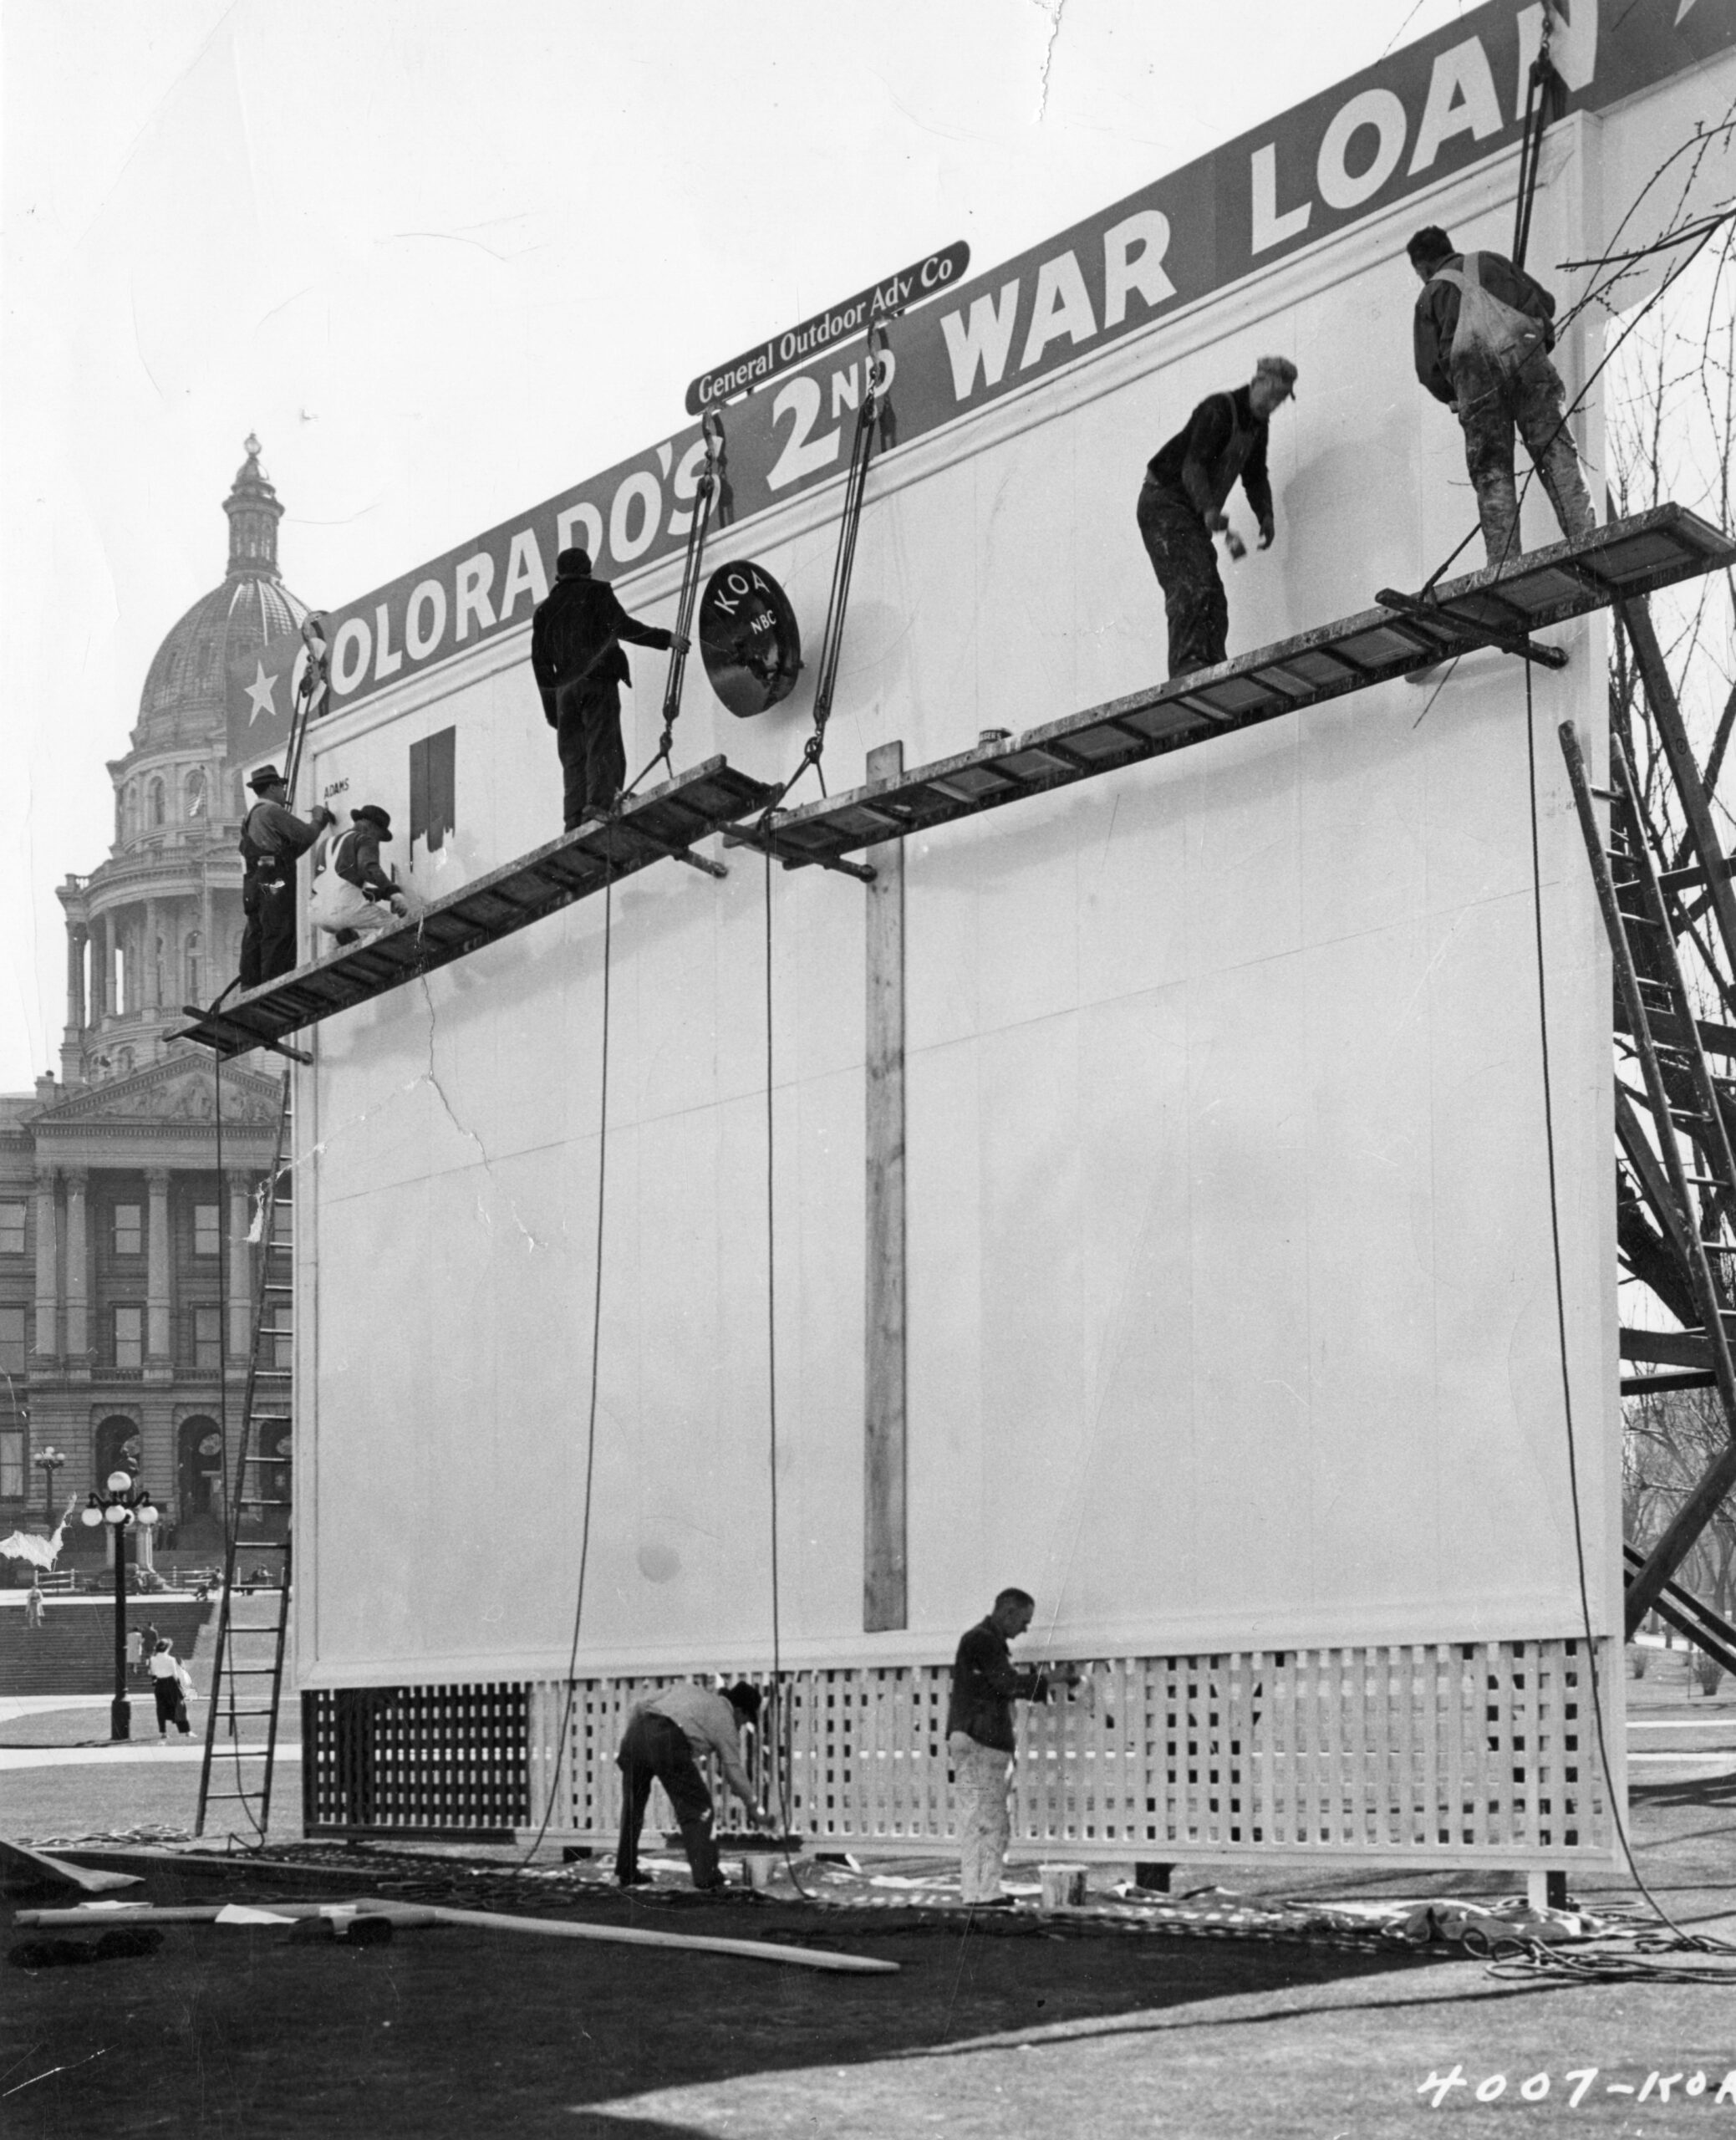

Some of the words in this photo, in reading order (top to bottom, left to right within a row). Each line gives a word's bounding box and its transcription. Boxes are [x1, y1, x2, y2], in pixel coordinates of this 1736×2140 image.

[699, 343, 774, 404] General
[780, 301, 867, 361] Outdoor
[870, 276, 914, 317] Adv
[921, 256, 953, 288] Co
[292, 435, 723, 715] COLORADO'S
[940, 209, 1177, 401] WAR
[1250, 0, 1598, 255] LOAN
[714, 569, 771, 615] KOA
[751, 609, 777, 635] NBC
[323, 777, 349, 800] ADAMS
